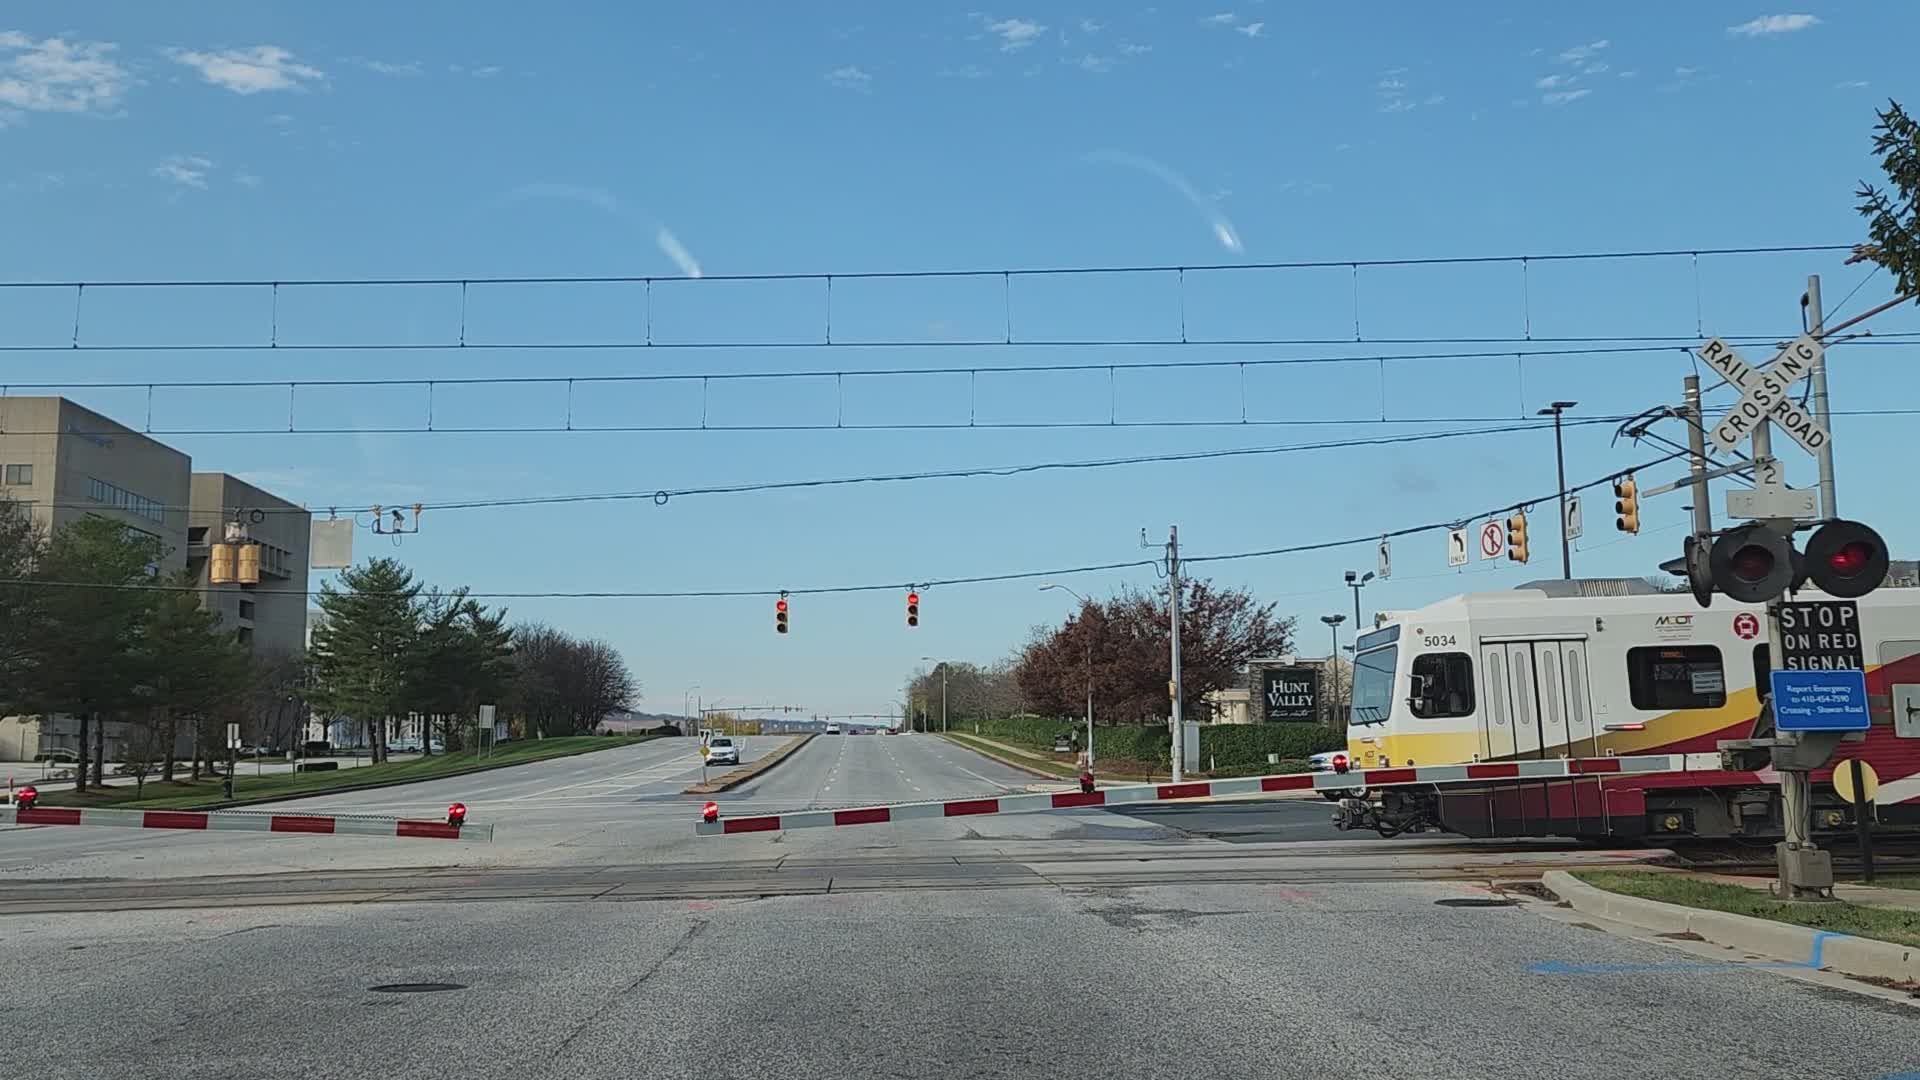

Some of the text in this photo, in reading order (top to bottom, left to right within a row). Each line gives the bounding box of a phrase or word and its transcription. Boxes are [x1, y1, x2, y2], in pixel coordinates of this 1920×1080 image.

[1704, 340, 1751, 387] RAIL
[1719, 343, 1815, 444] CROSSING
[1773, 399, 1825, 449] ROAD
[1763, 464, 1777, 484] 2
[1568, 526, 1581, 536] ONLY
[1450, 555, 1466, 564] ONLY
[1781, 606, 1854, 628] STOP
[1424, 635, 1457, 647] 5034
[1784, 633, 1857, 650] ON RED
[1787, 655, 1861, 671] SIGNAL
[1272, 680, 1310, 693] HUNT
[1786, 685, 1852, 694] Report Emergency
[1267, 693, 1314, 707] VALLEY
[1845, 705, 1864, 713] Road
